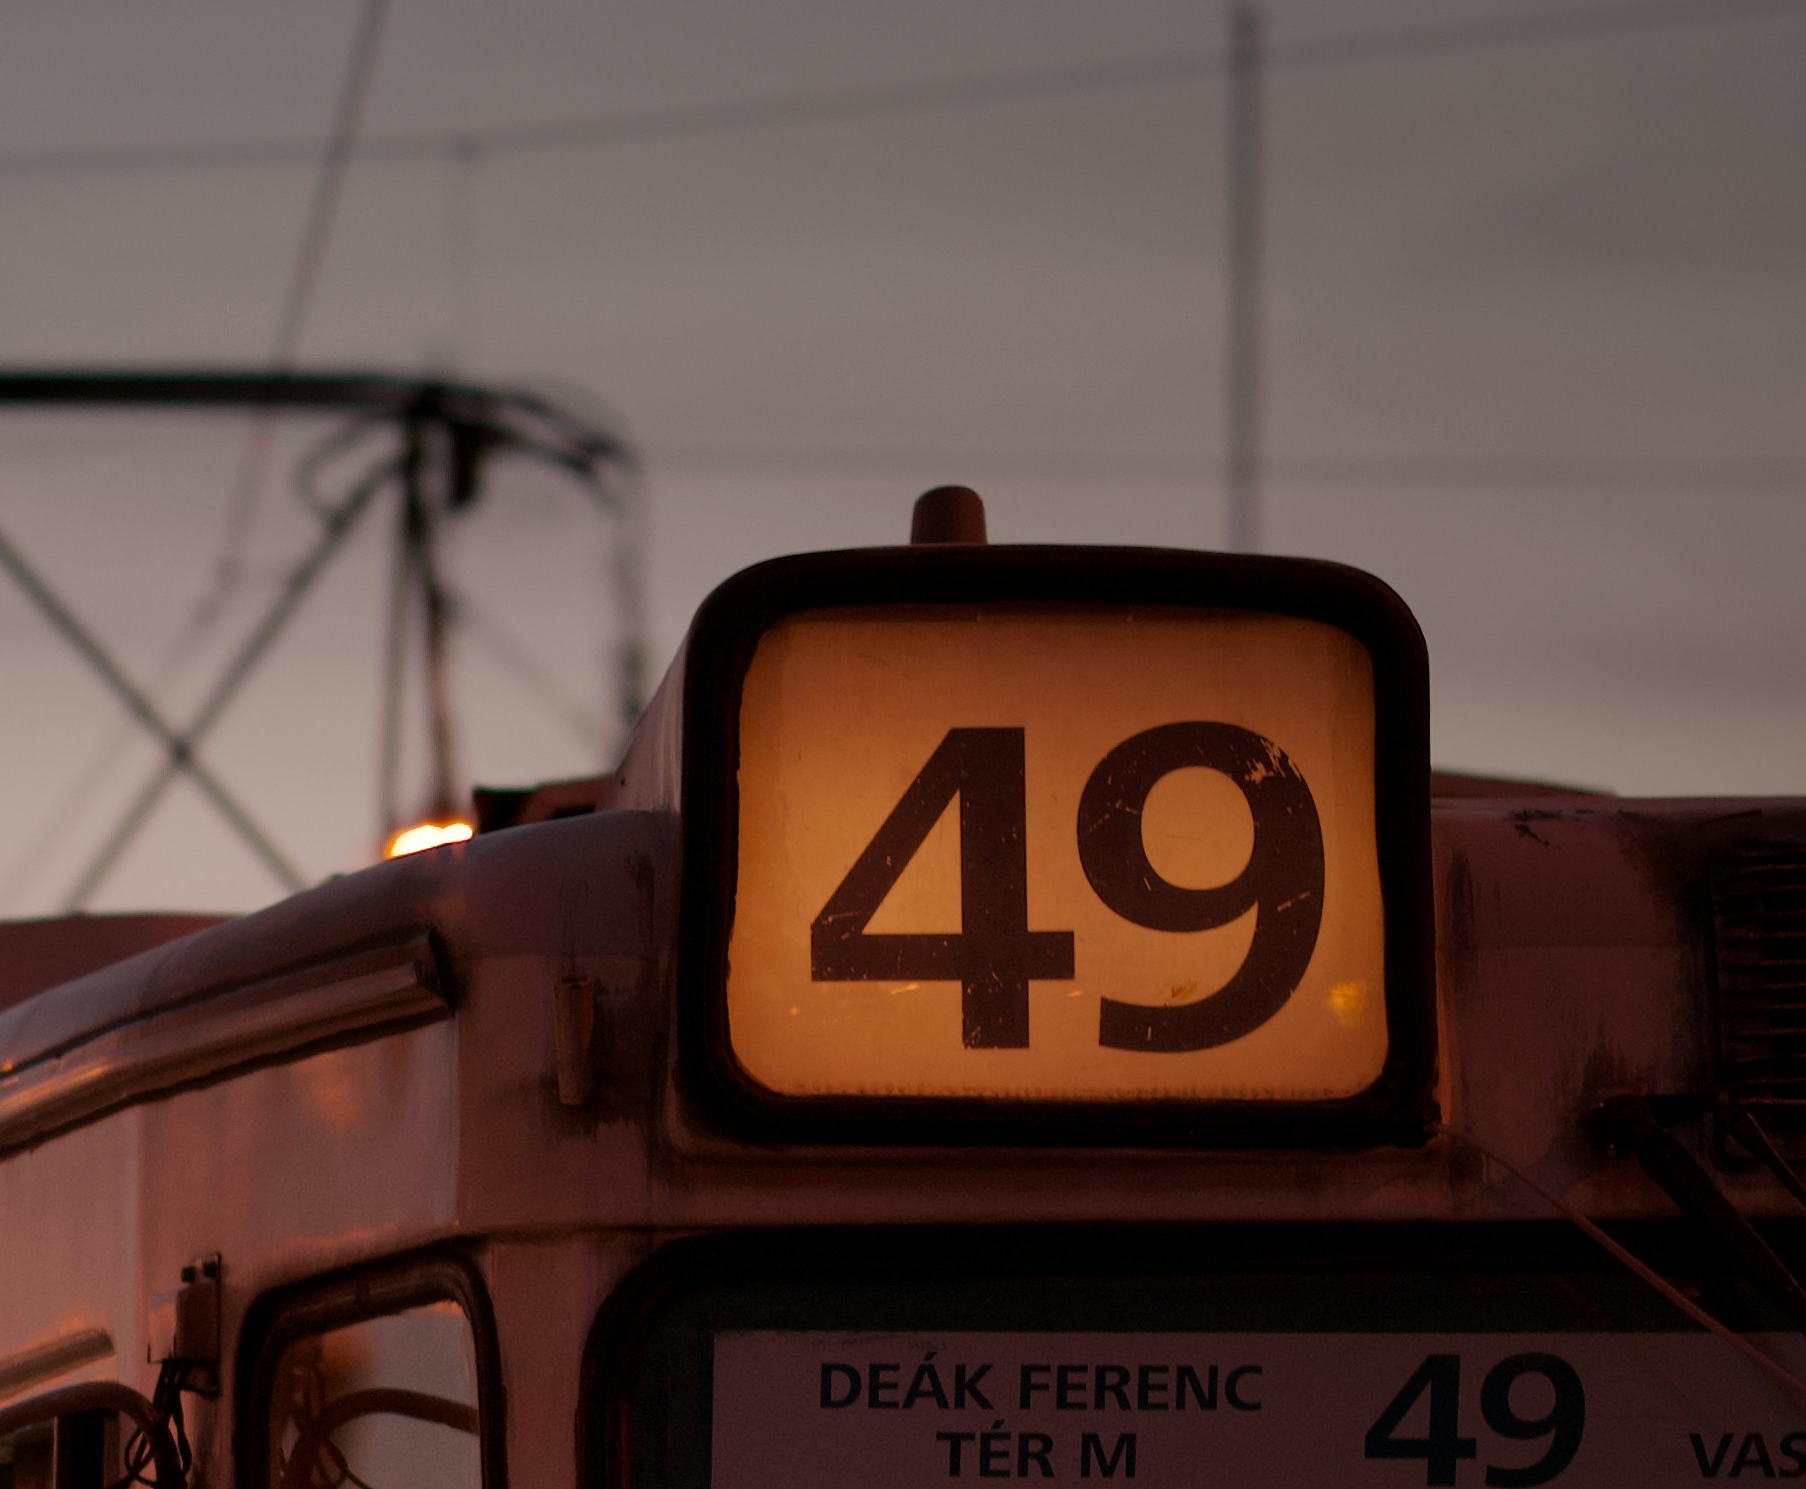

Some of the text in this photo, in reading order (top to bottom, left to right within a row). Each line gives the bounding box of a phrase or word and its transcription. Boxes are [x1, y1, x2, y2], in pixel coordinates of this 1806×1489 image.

[811, 721, 1324, 1053] 49
[819, 1351, 1263, 1411] DEÁK FERENC
[936, 1420, 1137, 1478] TÉR M
[1364, 1352, 1586, 1488] 49
[1689, 1431, 1806, 1478] VAS
